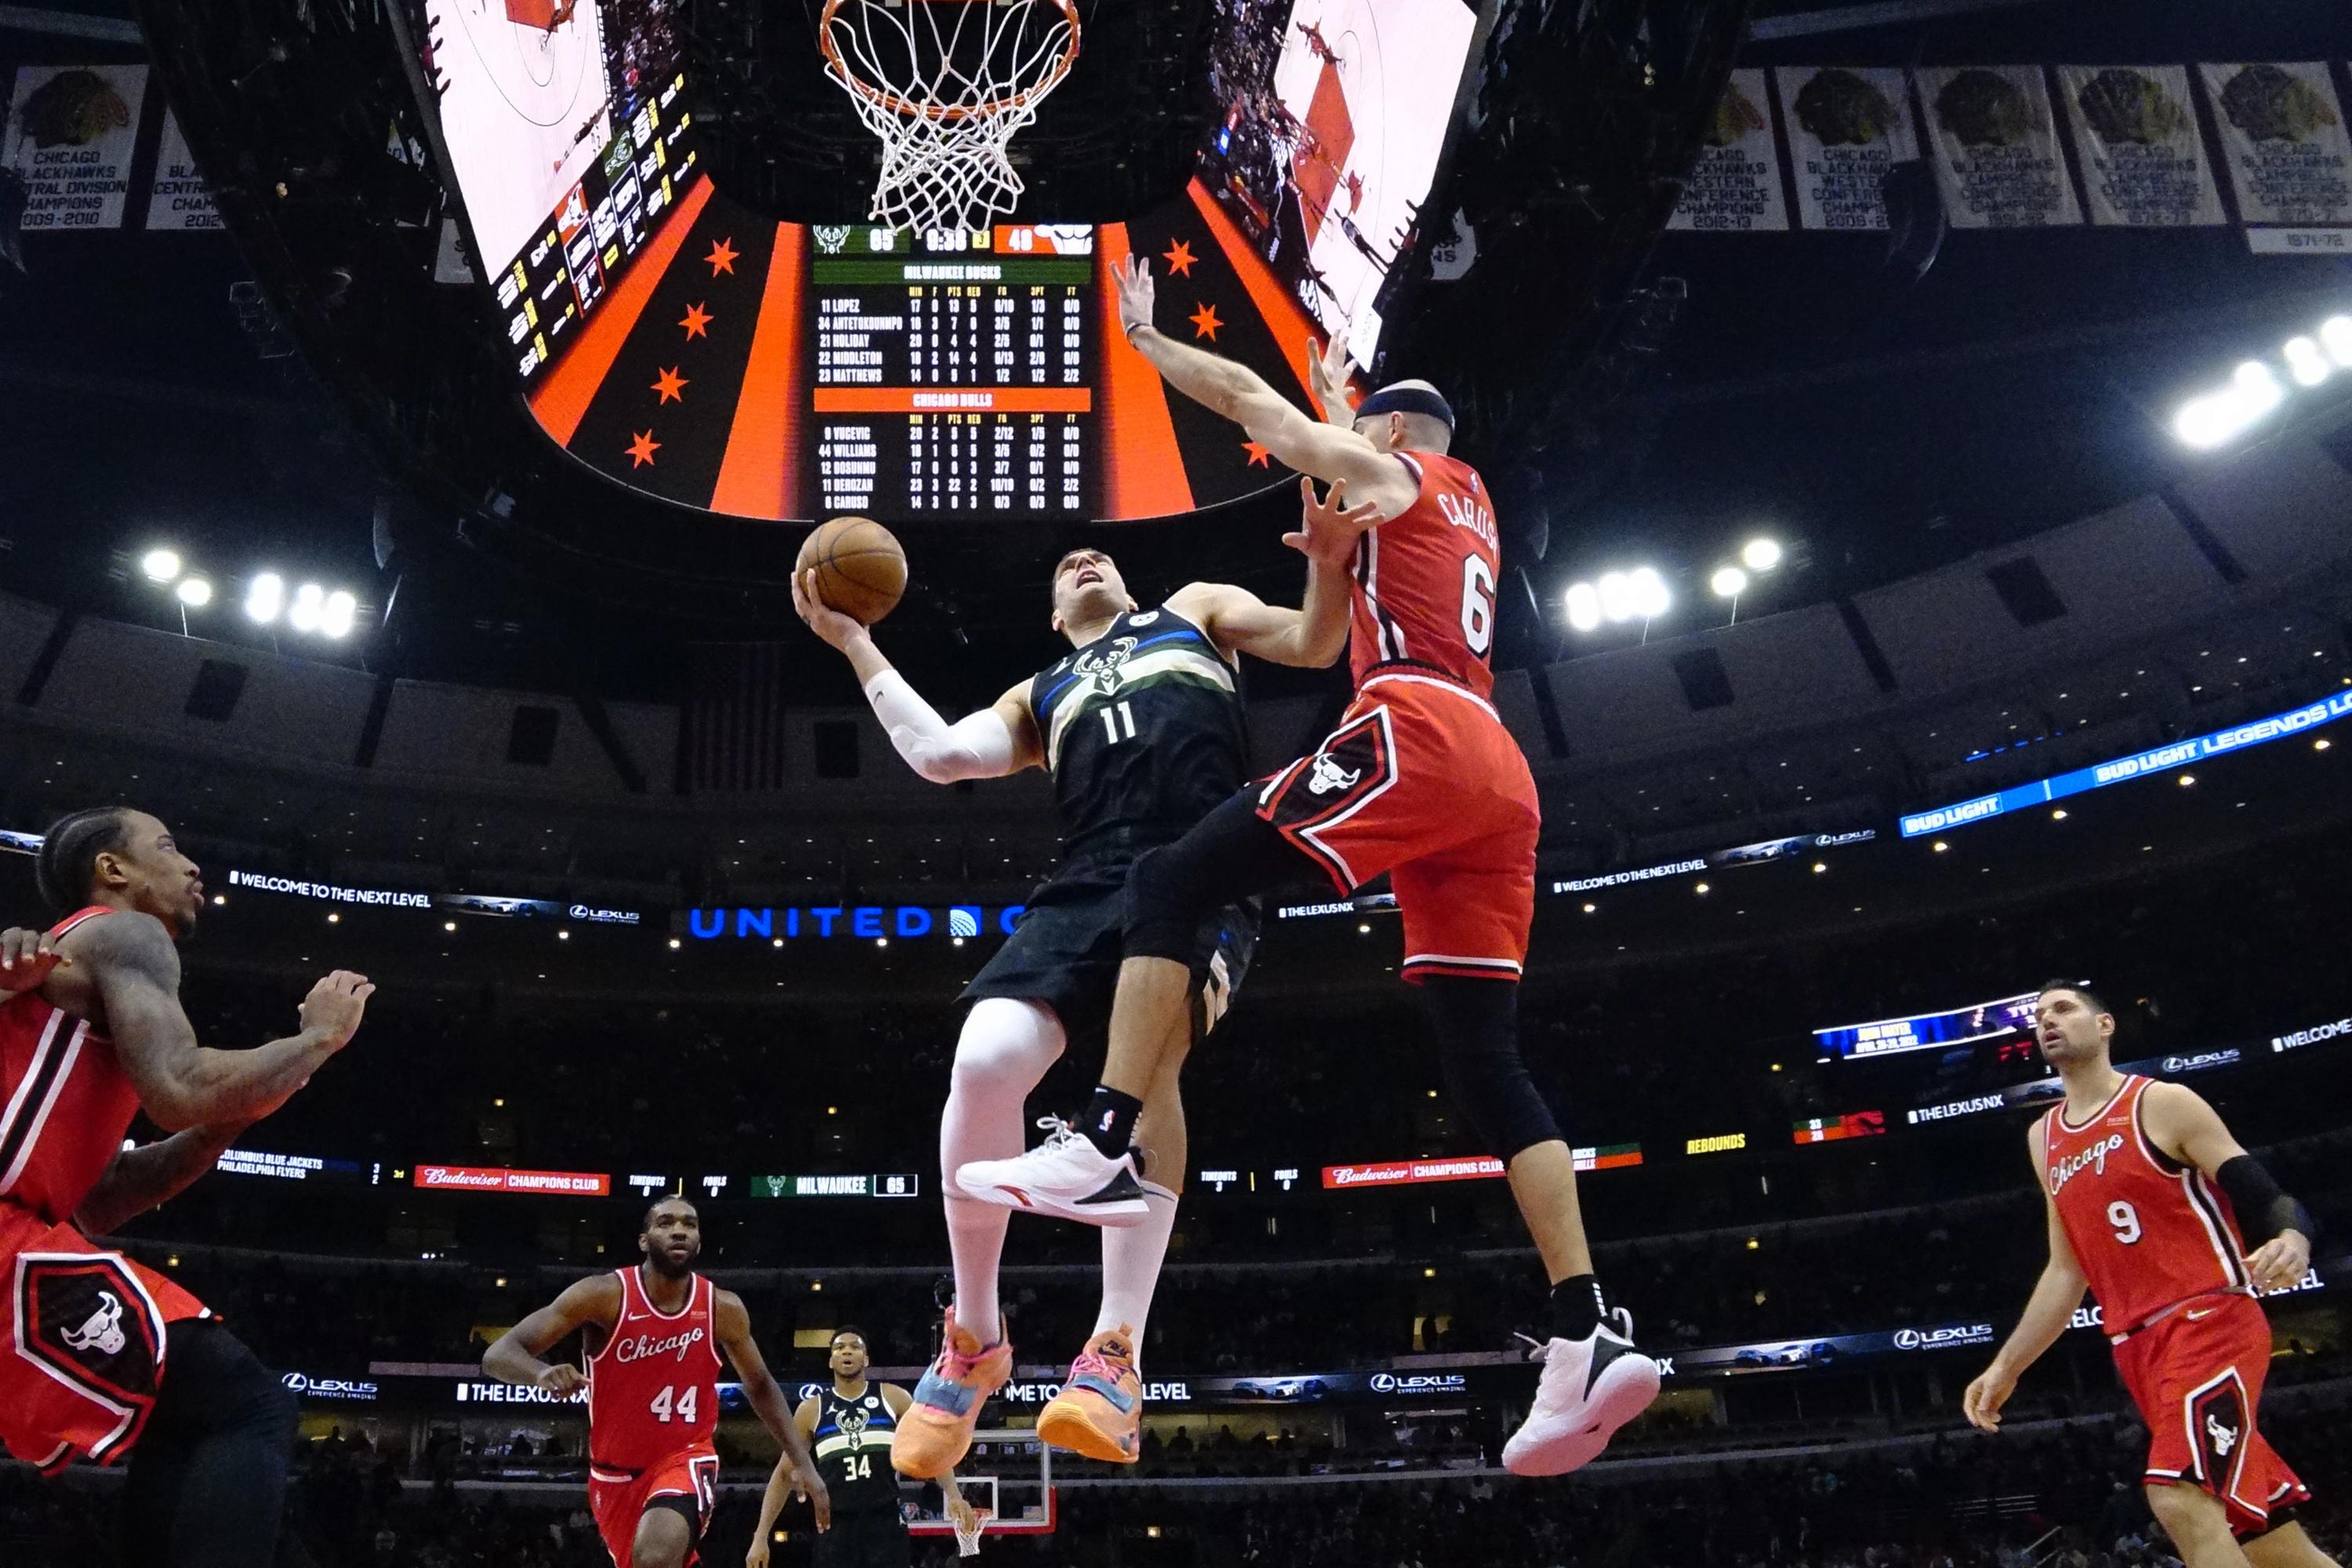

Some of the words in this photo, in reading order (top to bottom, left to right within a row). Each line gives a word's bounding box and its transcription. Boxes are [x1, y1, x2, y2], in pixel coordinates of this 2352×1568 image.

[34, 151, 100, 164] CHICAGO
[19, 166, 116, 180] LACKHAWKS
[67, 181, 127, 194] DIVISION
[25, 197, 103, 210] HAMPIONS
[870, 227, 895, 251] 65
[904, 266, 964, 279] MILWAUKEE
[965, 266, 1001, 279] BUCKS
[933, 287, 937, 296] F
[948, 286, 961, 296] PTS
[1067, 287, 1076, 296] FT
[822, 299, 830, 313] 11
[833, 299, 860, 313] LOPEZ
[910, 299, 920, 313] 17
[818, 317, 830, 330] 34
[833, 316, 902, 330] ANTETOKOUNMPO
[951, 316, 957, 330] 7
[1032, 316, 1044, 330] 1/1
[820, 334, 830, 347] 21
[833, 334, 869, 347] HOLIDAY
[909, 334, 922, 347] 20
[950, 334, 957, 347] 4
[970, 334, 977, 347] 4
[818, 351, 831, 365] 22
[833, 351, 882, 365] MIDDLETON
[931, 351, 938, 365] 2
[949, 351, 960, 365] 14
[970, 351, 977, 365] 4
[818, 368, 831, 382] 23
[833, 368, 882, 382] MATTHEWS
[911, 368, 921, 382] 14
[971, 368, 976, 382] 1
[996, 368, 1010, 383] 1/2
[1032, 368, 1045, 383] 1/2
[1064, 368, 1079, 383] 2/2
[913, 393, 958, 408] CHICAGO
[959, 394, 993, 408] BULLS
[933, 414, 938, 424] F
[948, 414, 961, 424] PTS
[1067, 414, 1076, 423] FT
[833, 426, 870, 440] VUCEVIC
[910, 426, 922, 441] 20
[932, 426, 938, 440] 2
[994, 426, 1014, 440] 2/12
[818, 444, 831, 457] 44
[833, 444, 877, 458] WILLIAMS
[933, 444, 938, 457] 1
[821, 461, 831, 474] 12
[833, 461, 876, 474] DOSUNMU
[911, 461, 921, 474] 17
[995, 461, 1010, 474] 3/7
[822, 479, 831, 492] 11
[833, 478, 873, 492] DEROZAN
[910, 478, 922, 492] 23
[932, 478, 938, 492] 3
[949, 478, 960, 492] 22
[970, 478, 977, 492] 2
[1064, 478, 1079, 492] 2/2
[833, 495, 869, 509] CARUSO
[911, 495, 922, 509] 14
[1461, 553, 1494, 654] 6
[1100, 701, 1136, 744] 11
[2097, 760, 2142, 782] BUD
[2143, 743, 2196, 770] LIGHT
[2203, 706, 2329, 753] LEGENDS
[1905, 814, 1945, 833] BUD
[1946, 798, 1997, 823] LIGHT
[1832, 829, 1875, 842] LEXUS
[1563, 875, 1613, 891] WELCOME
[1614, 873, 1629, 883] TO
[1629, 869, 1649, 880] THE
[1649, 864, 1675, 878] NEXT
[1675, 859, 1708, 873] LEVEL
[241, 873, 310, 895] WELCOME
[312, 884, 329, 898] TO
[331, 887, 356, 902] THE
[357, 890, 391, 904] NEXT
[393, 893, 430, 907] LEVEL
[589, 909, 640, 920] LEXUS
[1287, 906, 1309, 916] THE
[1310, 903, 1338, 915] LEXUS
[1338, 902, 1354, 912] NX
[691, 907, 932, 938] UNITED
[2284, 1023, 2352, 1047] WELCOME
[2184, 1049, 2240, 1065] LEXUS
[1919, 1106, 1943, 1121] THE
[1944, 1100, 1980, 1117] LEXUS
[1981, 1094, 2004, 1110] NX
[1687, 1134, 1745, 1154] REBOUNDS
[216, 1159, 275, 1176] PHILADELPHIA
[275, 1167, 307, 1181] FLYERS
[372, 1174, 379, 1184] 2
[265, 1154, 285, 1167] BLUE
[286, 1156, 323, 1171] JACKETS
[373, 1163, 379, 1174] 3
[2050, 1134, 2124, 1196] Chicago
[424, 1168, 502, 1185] Budweiser
[508, 1175, 570, 1189] CHAMPIONS
[572, 1178, 599, 1190] CLUB
[702, 1174, 728, 1187] FOULS
[1274, 1169, 1298, 1180] FOULS
[1333, 1168, 1408, 1184] Budweiser
[1414, 1162, 1477, 1177] CHAMPIONS
[797, 1176, 866, 1194] MILWAUKEE
[887, 1177, 905, 1193] 65
[2107, 1200, 2142, 1244] 9
[1922, 1323, 1993, 1341] LEXUS
[616, 1327, 704, 1363] Chicago
[308, 1379, 377, 1392] LEXUS
[1396, 1375, 1465, 1388] LEXUS
[472, 1385, 503, 1401] THE
[1036, 1384, 1058, 1402] TO
[1142, 1384, 1191, 1399] LEVEL
[651, 1385, 698, 1423] 44
[843, 1455, 872, 1482] 34
